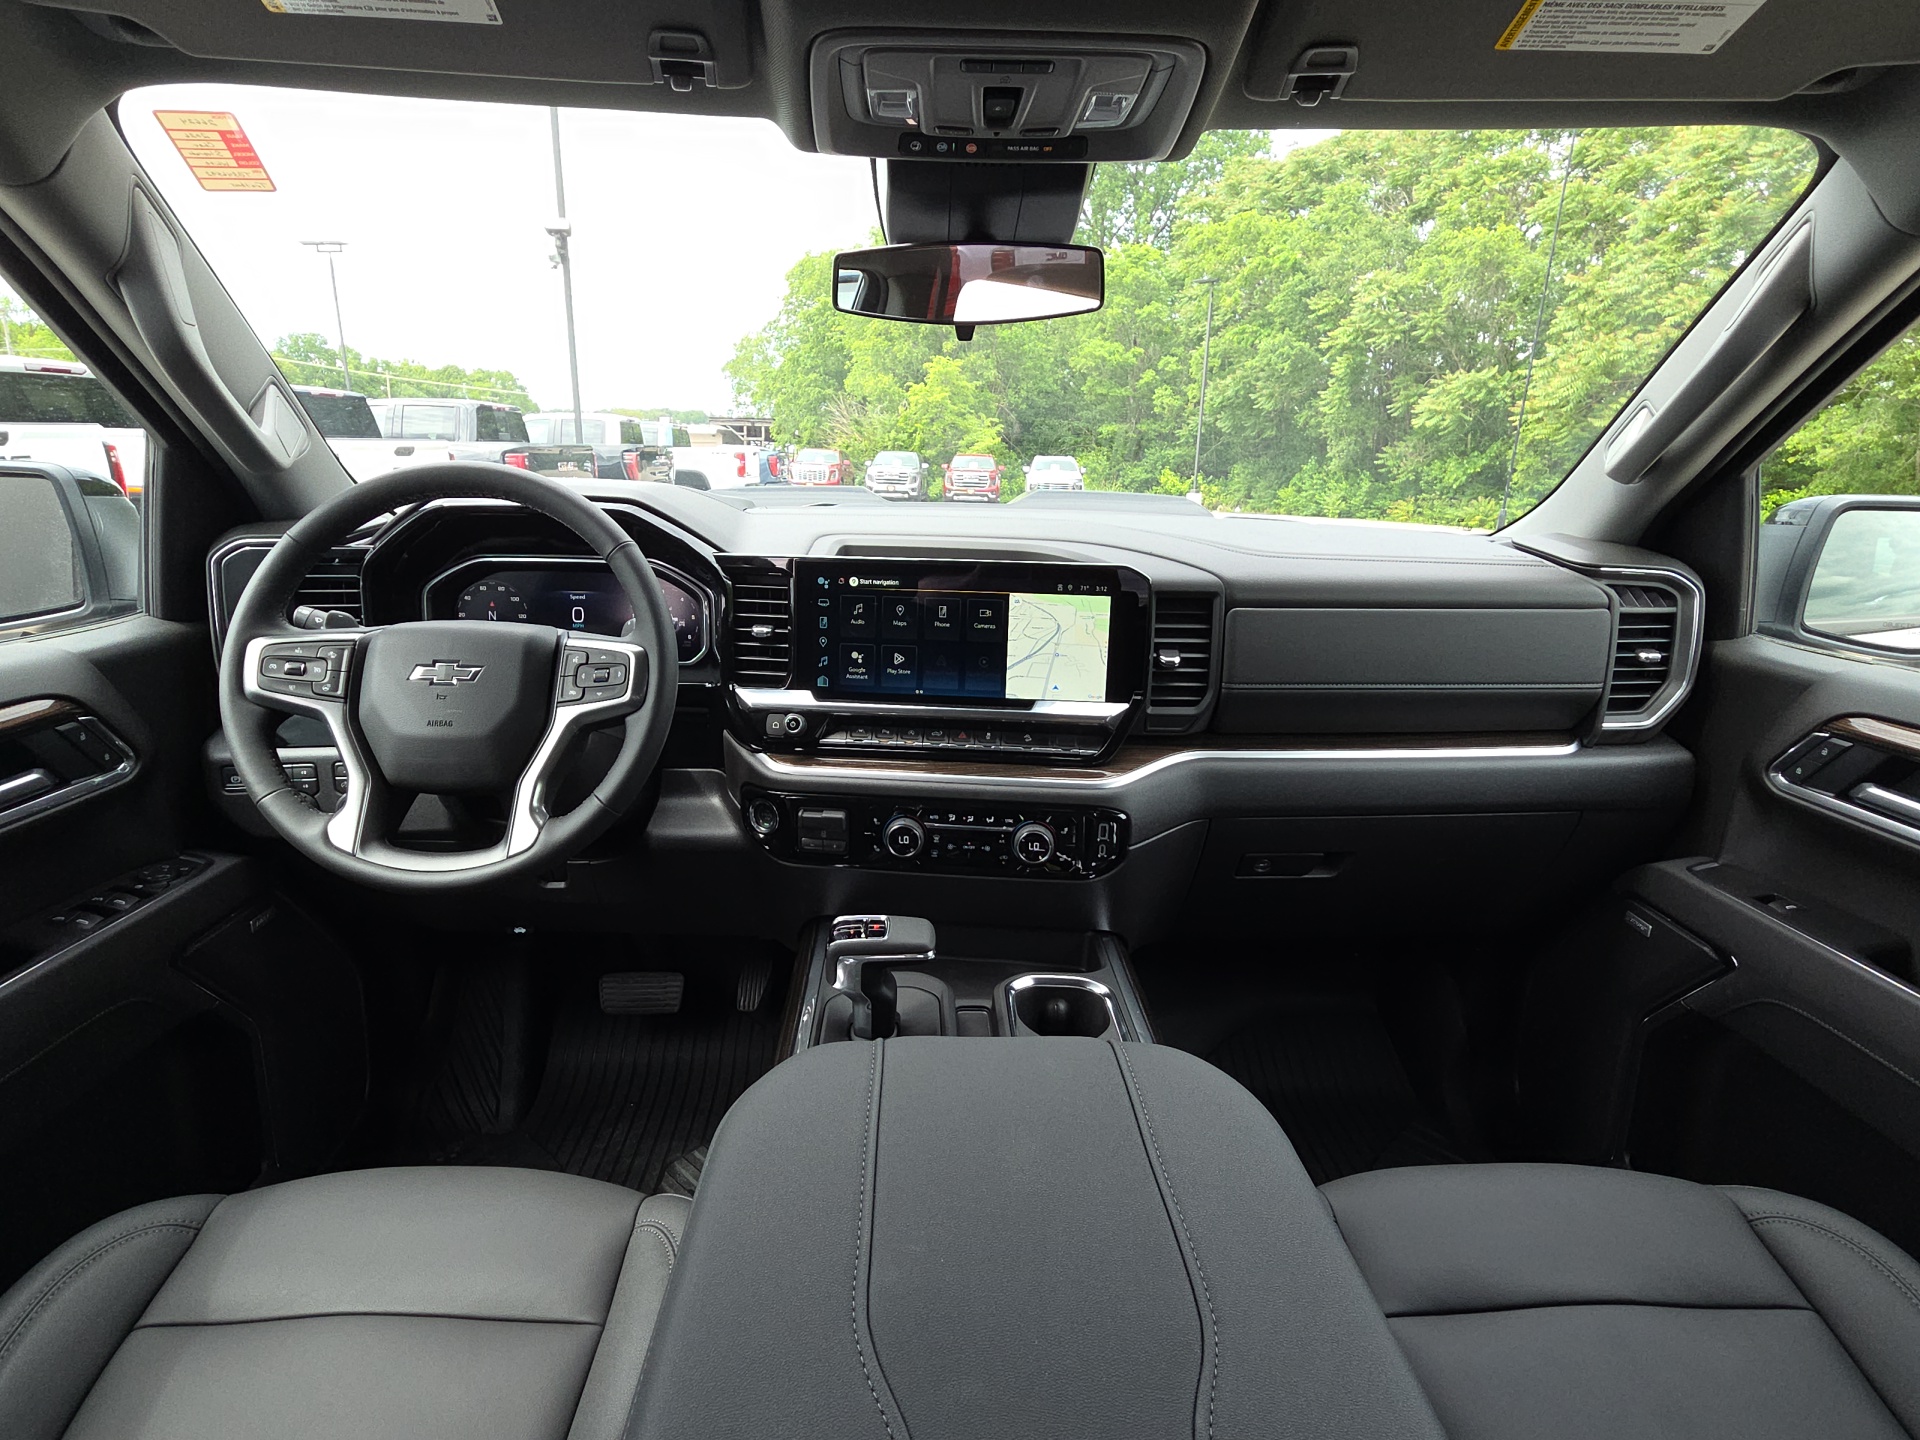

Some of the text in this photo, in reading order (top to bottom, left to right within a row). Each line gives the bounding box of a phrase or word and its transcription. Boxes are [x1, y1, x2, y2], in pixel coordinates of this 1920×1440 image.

[873, 579, 900, 587] navigation
[569, 593, 586, 601] Speed
[488, 610, 497, 621] N
[571, 606, 585, 623] 0
[892, 619, 907, 627] Maps
[934, 620, 951, 628] Phone
[973, 622, 996, 630] Cameras
[848, 666, 866, 674] Google
[886, 667, 897, 675] Play
[426, 719, 454, 727] AIRBAG
[898, 835, 910, 844] LO
